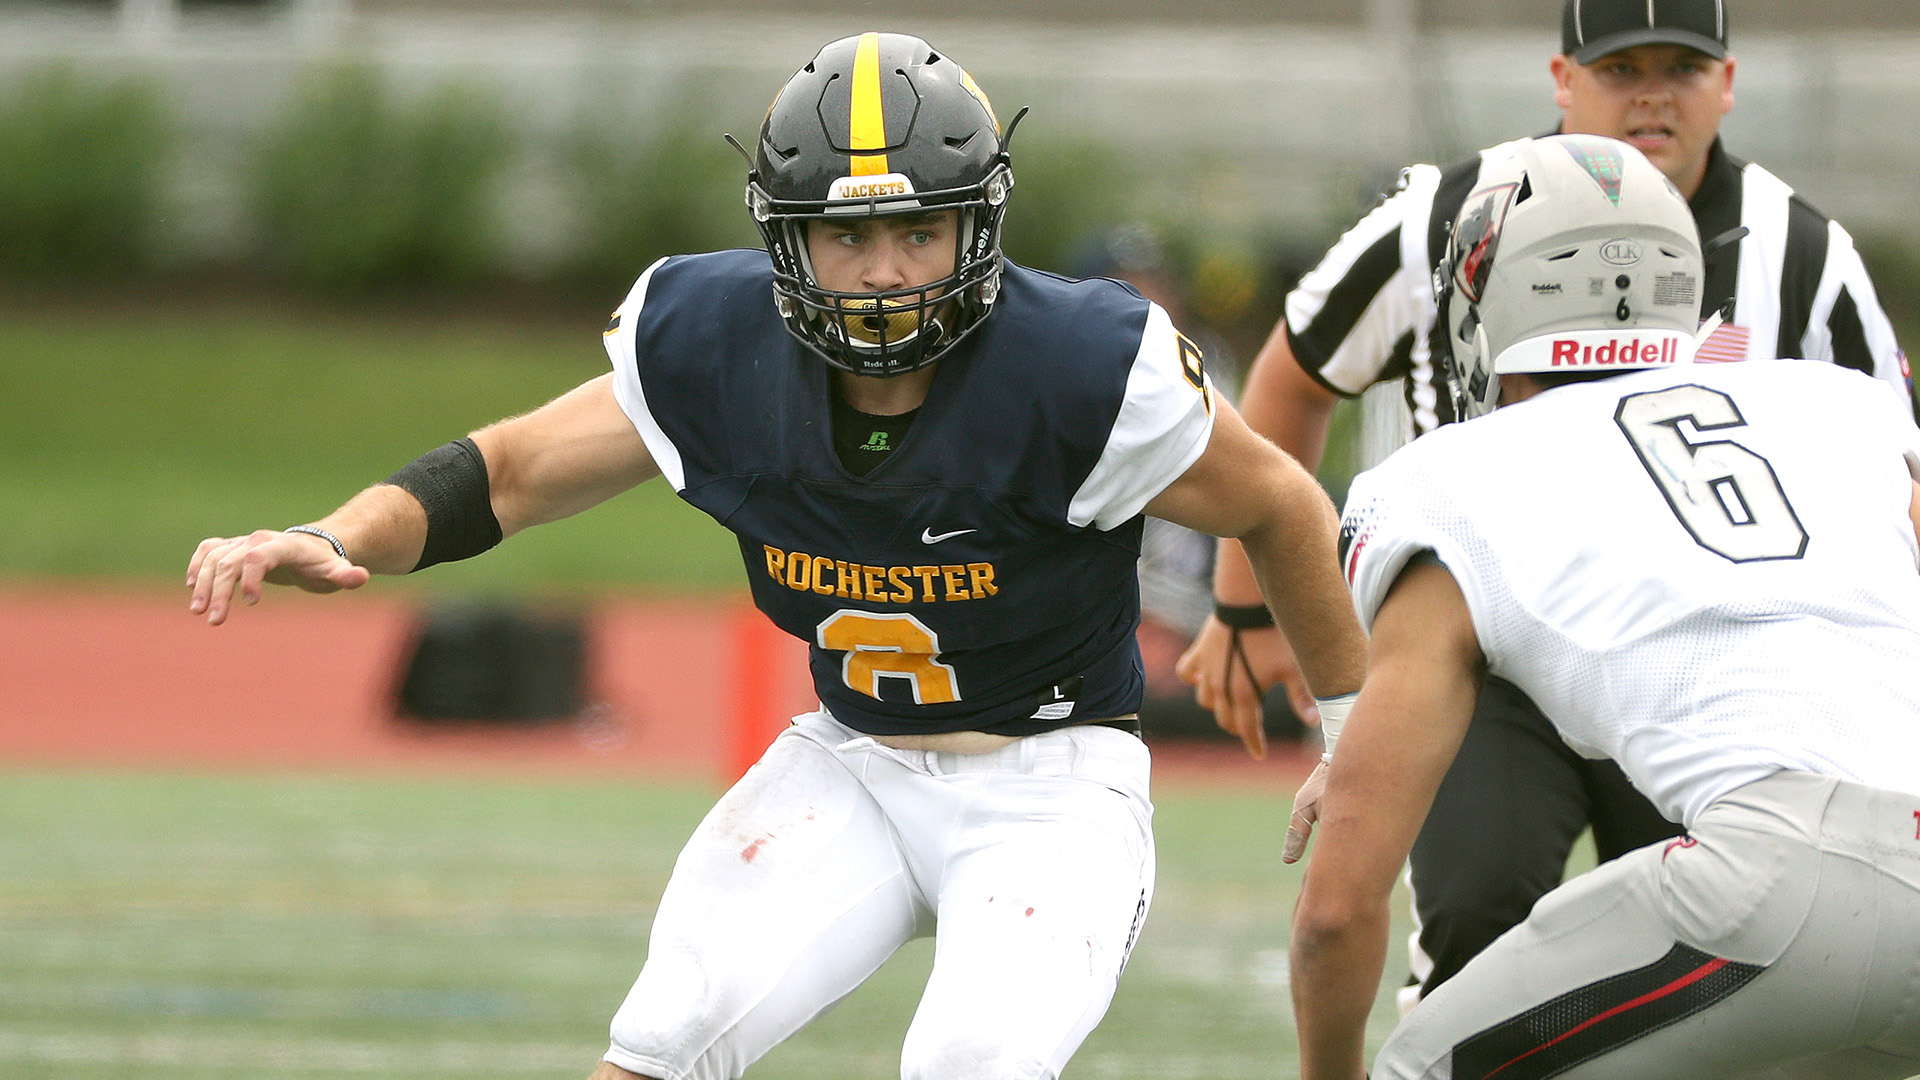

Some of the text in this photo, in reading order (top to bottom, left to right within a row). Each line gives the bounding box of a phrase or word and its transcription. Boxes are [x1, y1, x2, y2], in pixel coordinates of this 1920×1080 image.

[1604, 244, 1638, 260] CLK
[1616, 296, 1631, 321] 6
[1551, 338, 1678, 366] Riddell
[1613, 383, 1810, 564] 6
[763, 544, 999, 604] ROCHESTER
[1053, 685, 1065, 699] L
